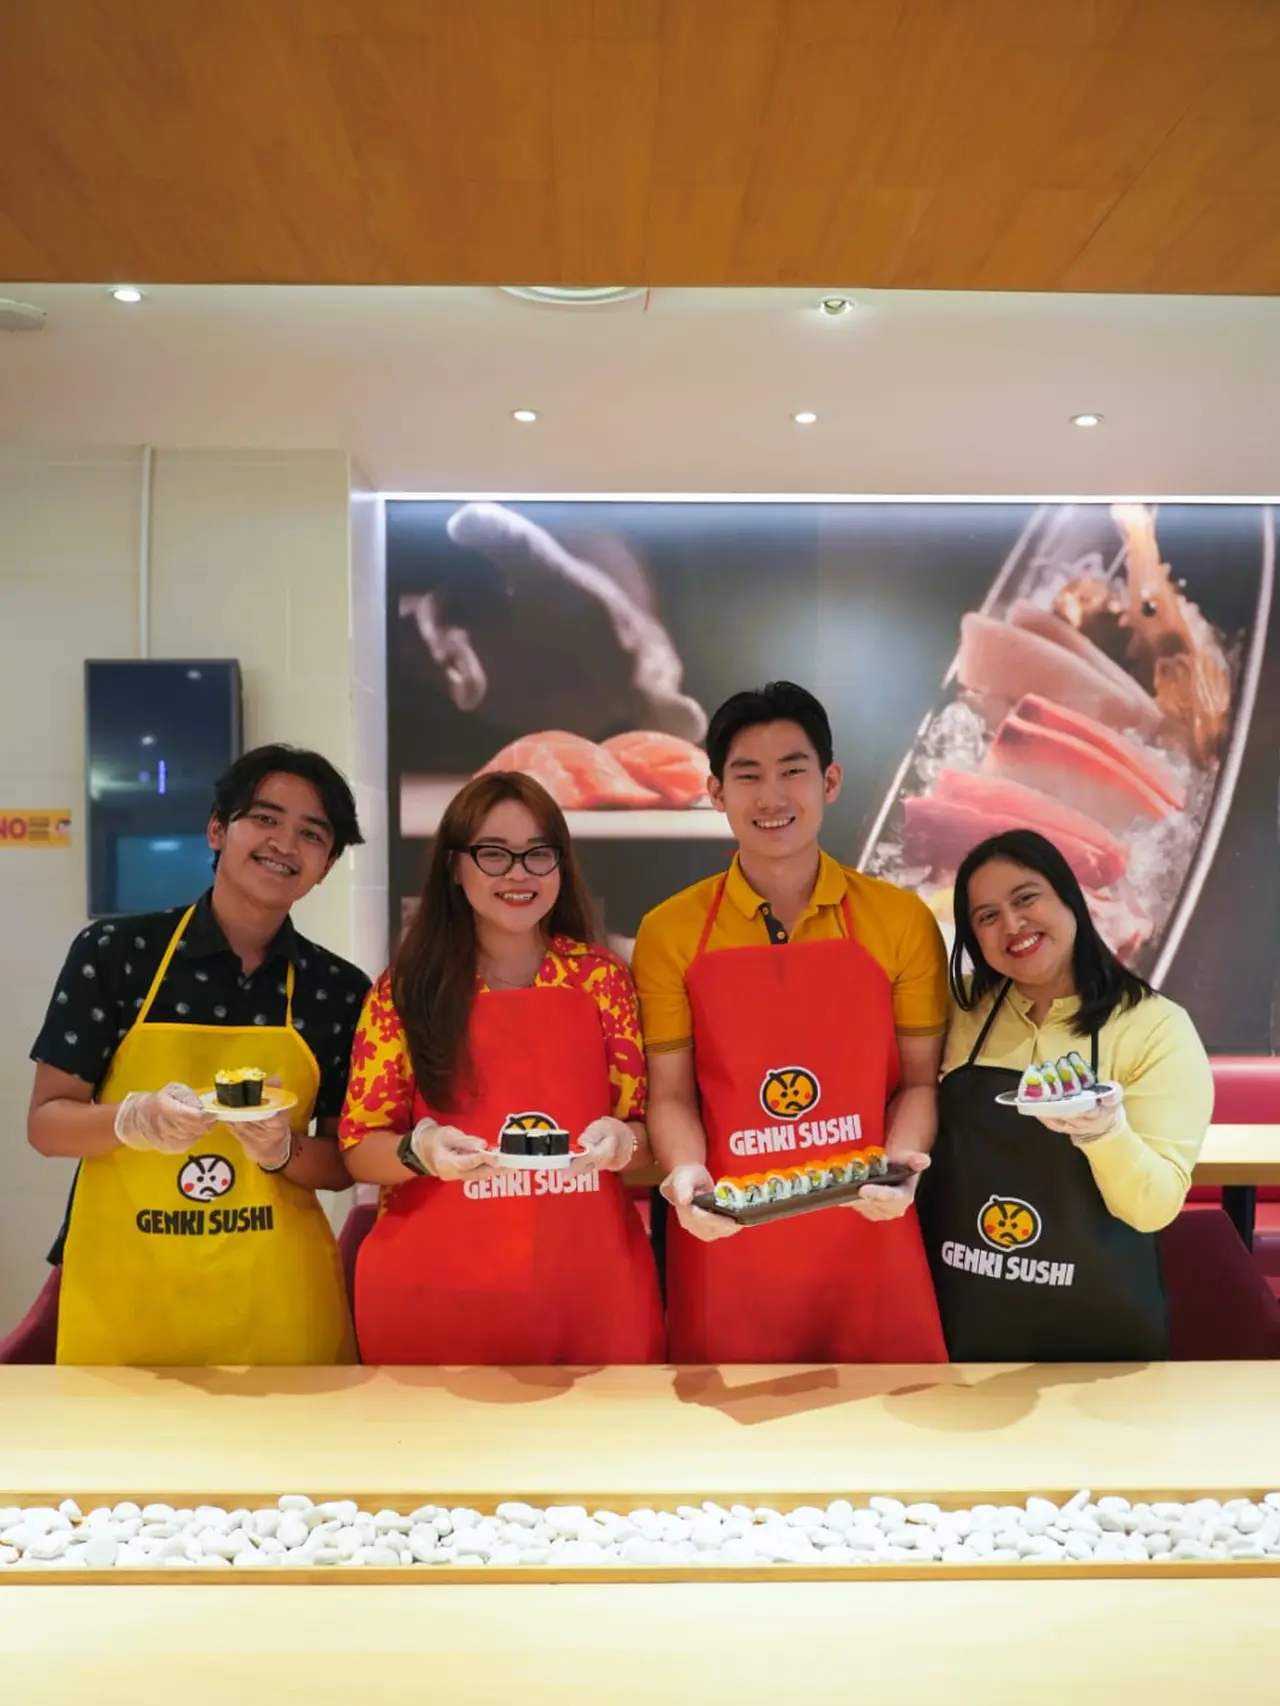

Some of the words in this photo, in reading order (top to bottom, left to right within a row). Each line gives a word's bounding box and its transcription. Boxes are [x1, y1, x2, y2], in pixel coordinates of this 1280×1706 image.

[730, 1124, 796, 1156] GENKI
[798, 1114, 862, 1148] SUSHI
[463, 1170, 531, 1200] GENKI
[136, 1209, 205, 1235] GENKI
[208, 1205, 274, 1235] SUSHI
[941, 1241, 1003, 1279] GENKI
[1005, 1256, 1075, 1286] SUSHI
